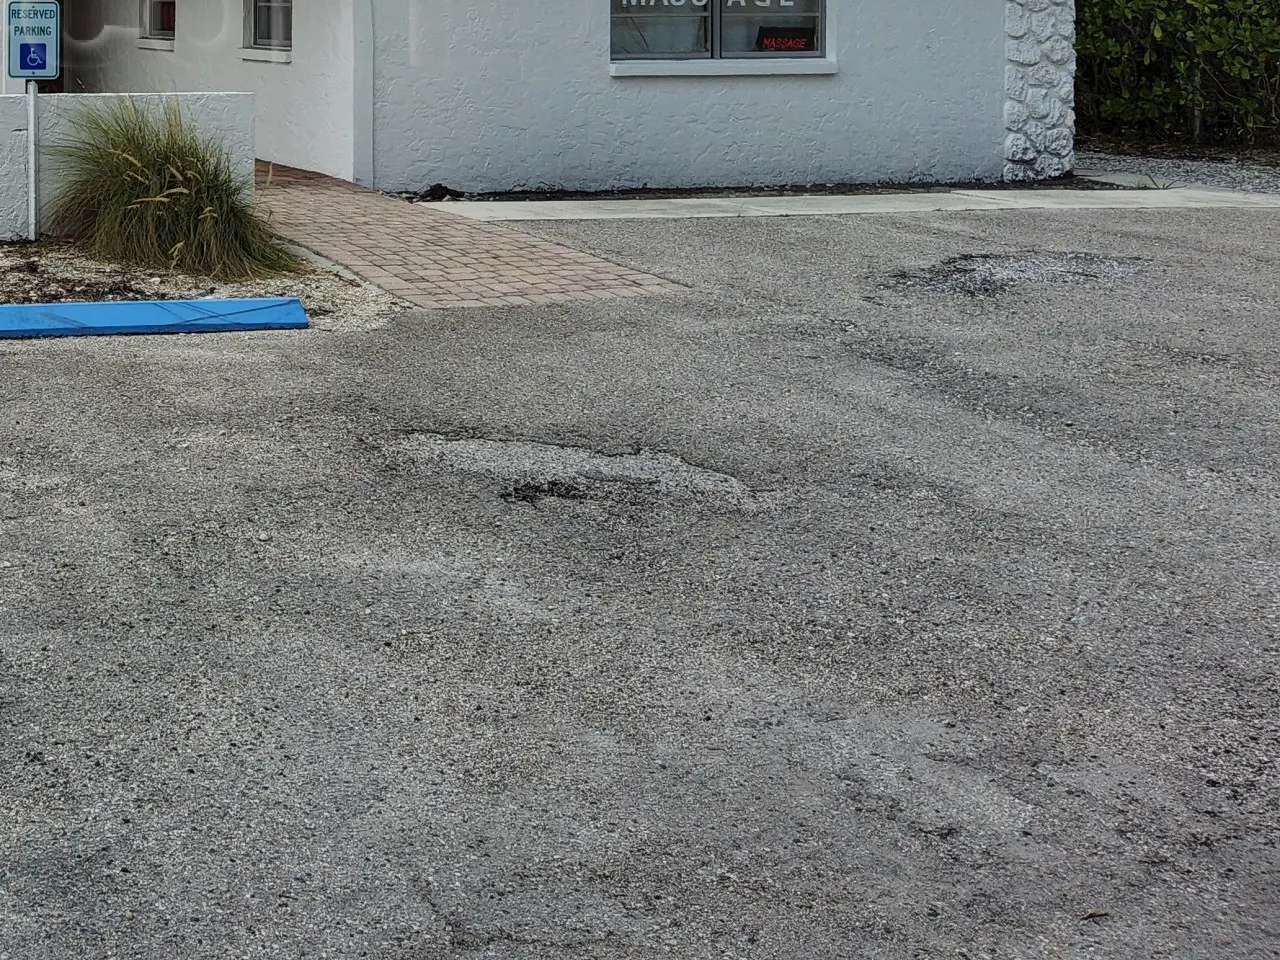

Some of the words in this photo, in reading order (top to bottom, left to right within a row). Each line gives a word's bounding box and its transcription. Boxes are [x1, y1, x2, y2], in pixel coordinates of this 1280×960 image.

[11, 9, 56, 19] RESERVED
[14, 26, 52, 36] PARKING
[762, 37, 807, 48] MASSAGE
